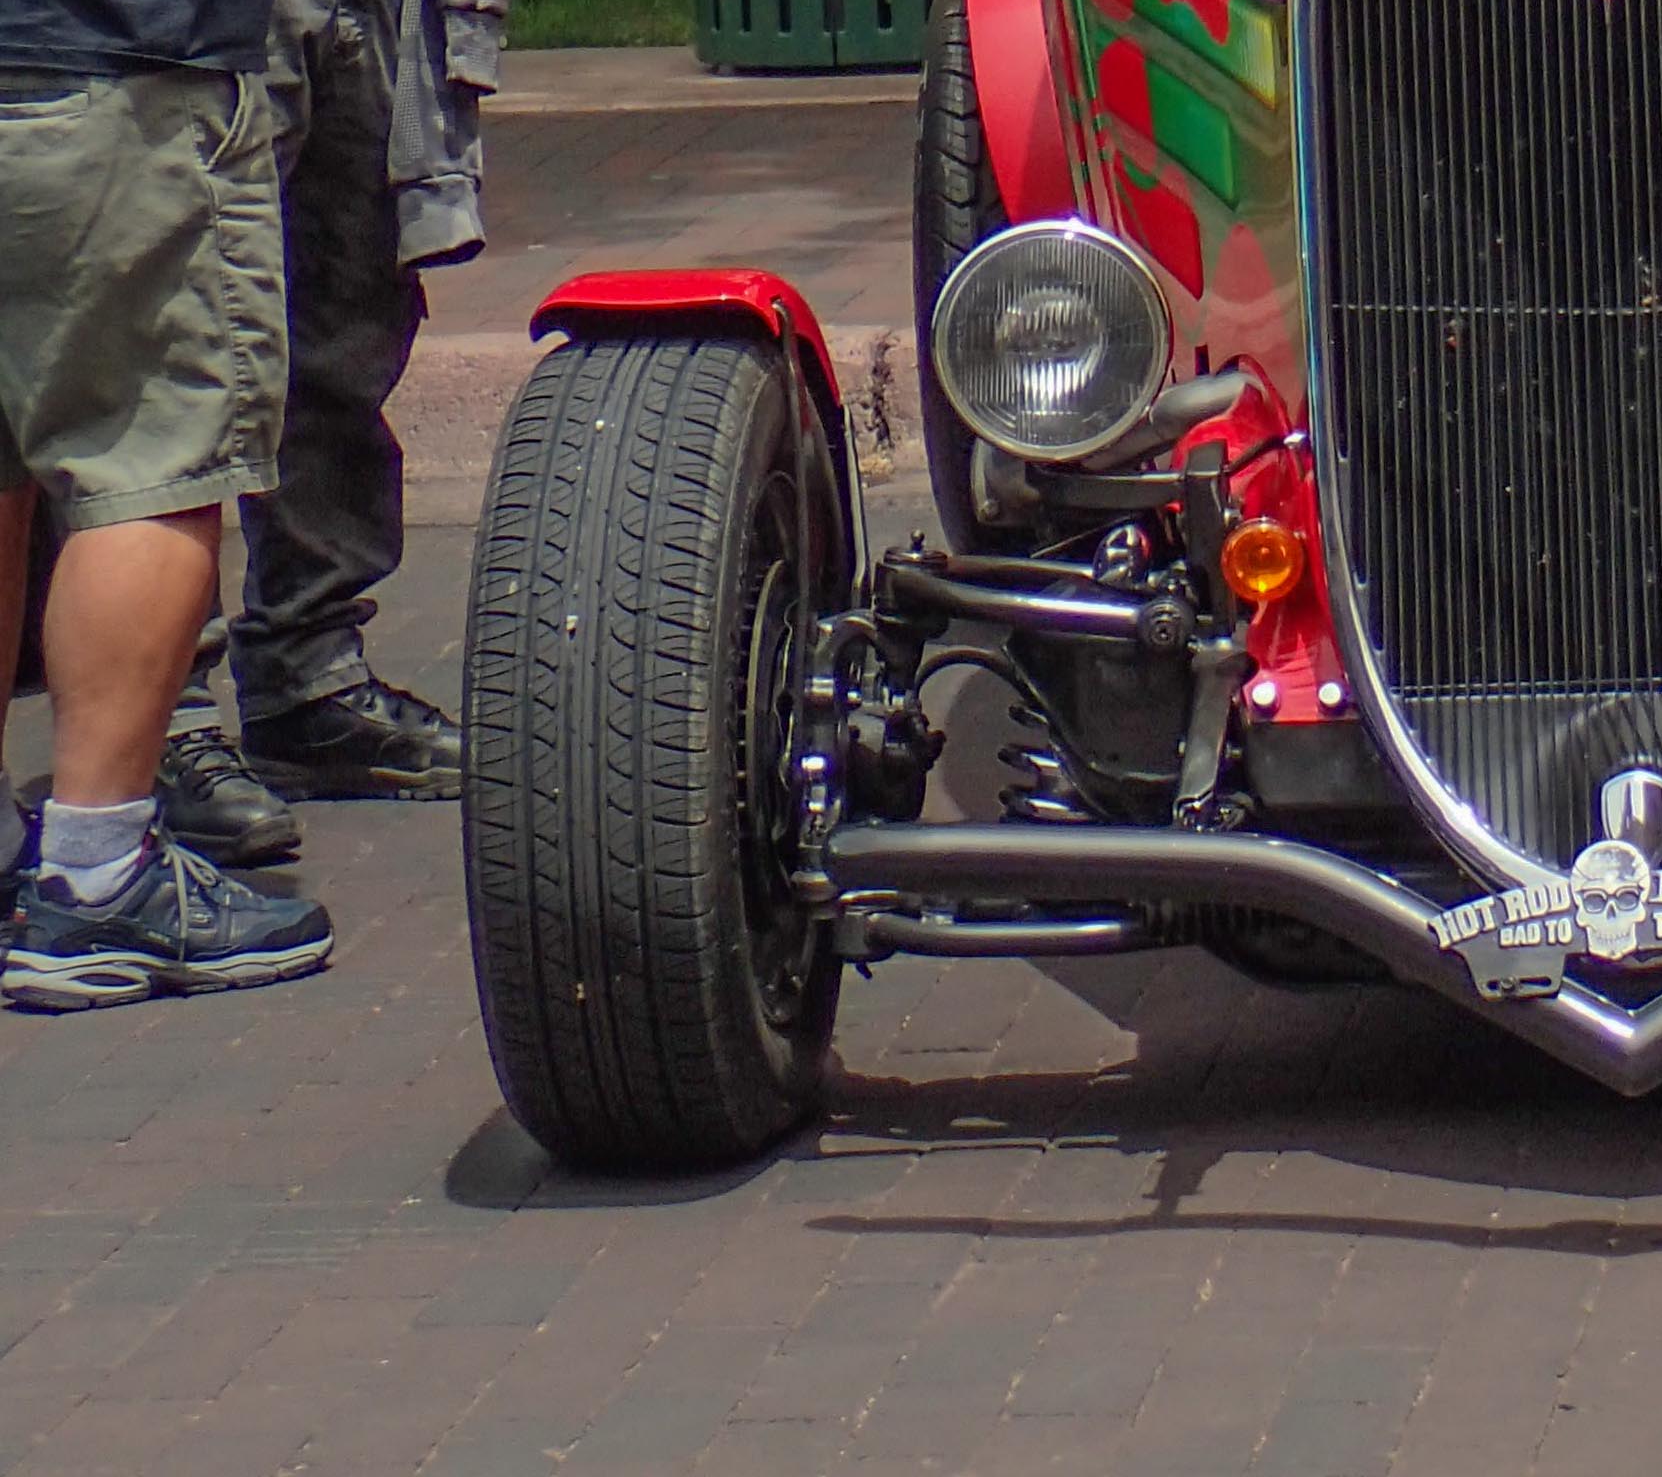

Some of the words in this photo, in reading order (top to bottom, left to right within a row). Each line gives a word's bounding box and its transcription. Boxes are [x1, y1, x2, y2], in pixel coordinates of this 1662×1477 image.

[1433, 898, 1495, 949] HOT
[1502, 880, 1571, 924] ROD
[1500, 925, 1540, 946] BAD
[1545, 917, 1573, 944] TO
